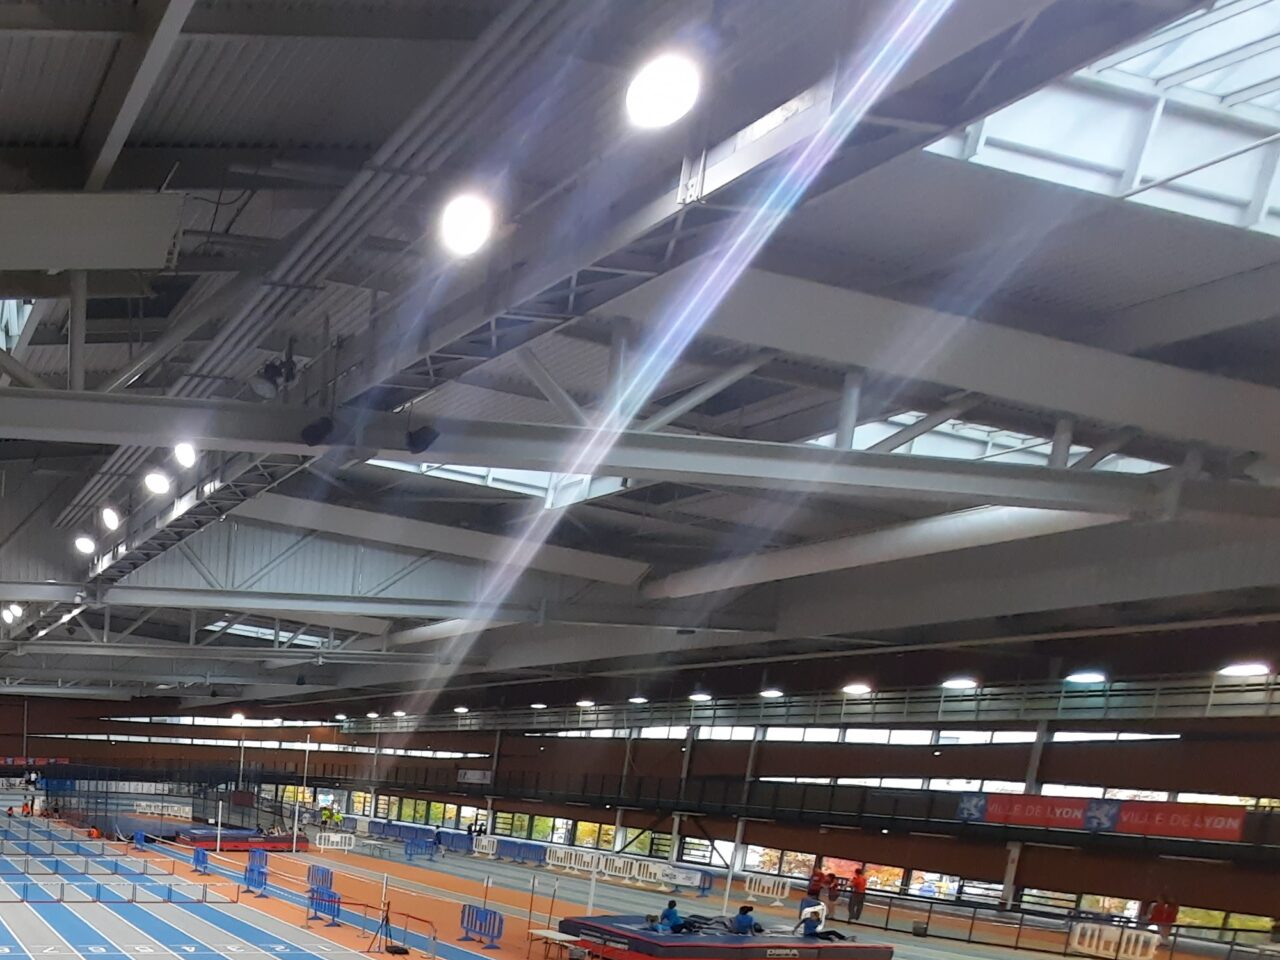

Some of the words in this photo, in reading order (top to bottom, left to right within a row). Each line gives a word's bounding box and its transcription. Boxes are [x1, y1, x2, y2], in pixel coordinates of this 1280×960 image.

[989, 802, 1022, 815] VILLE
[1025, 804, 1043, 817] DE
[1047, 805, 1084, 819] LYON
[1121, 809, 1164, 825] VILLE
[1169, 813, 1191, 828] DE
[1192, 815, 1241, 830] LYON
